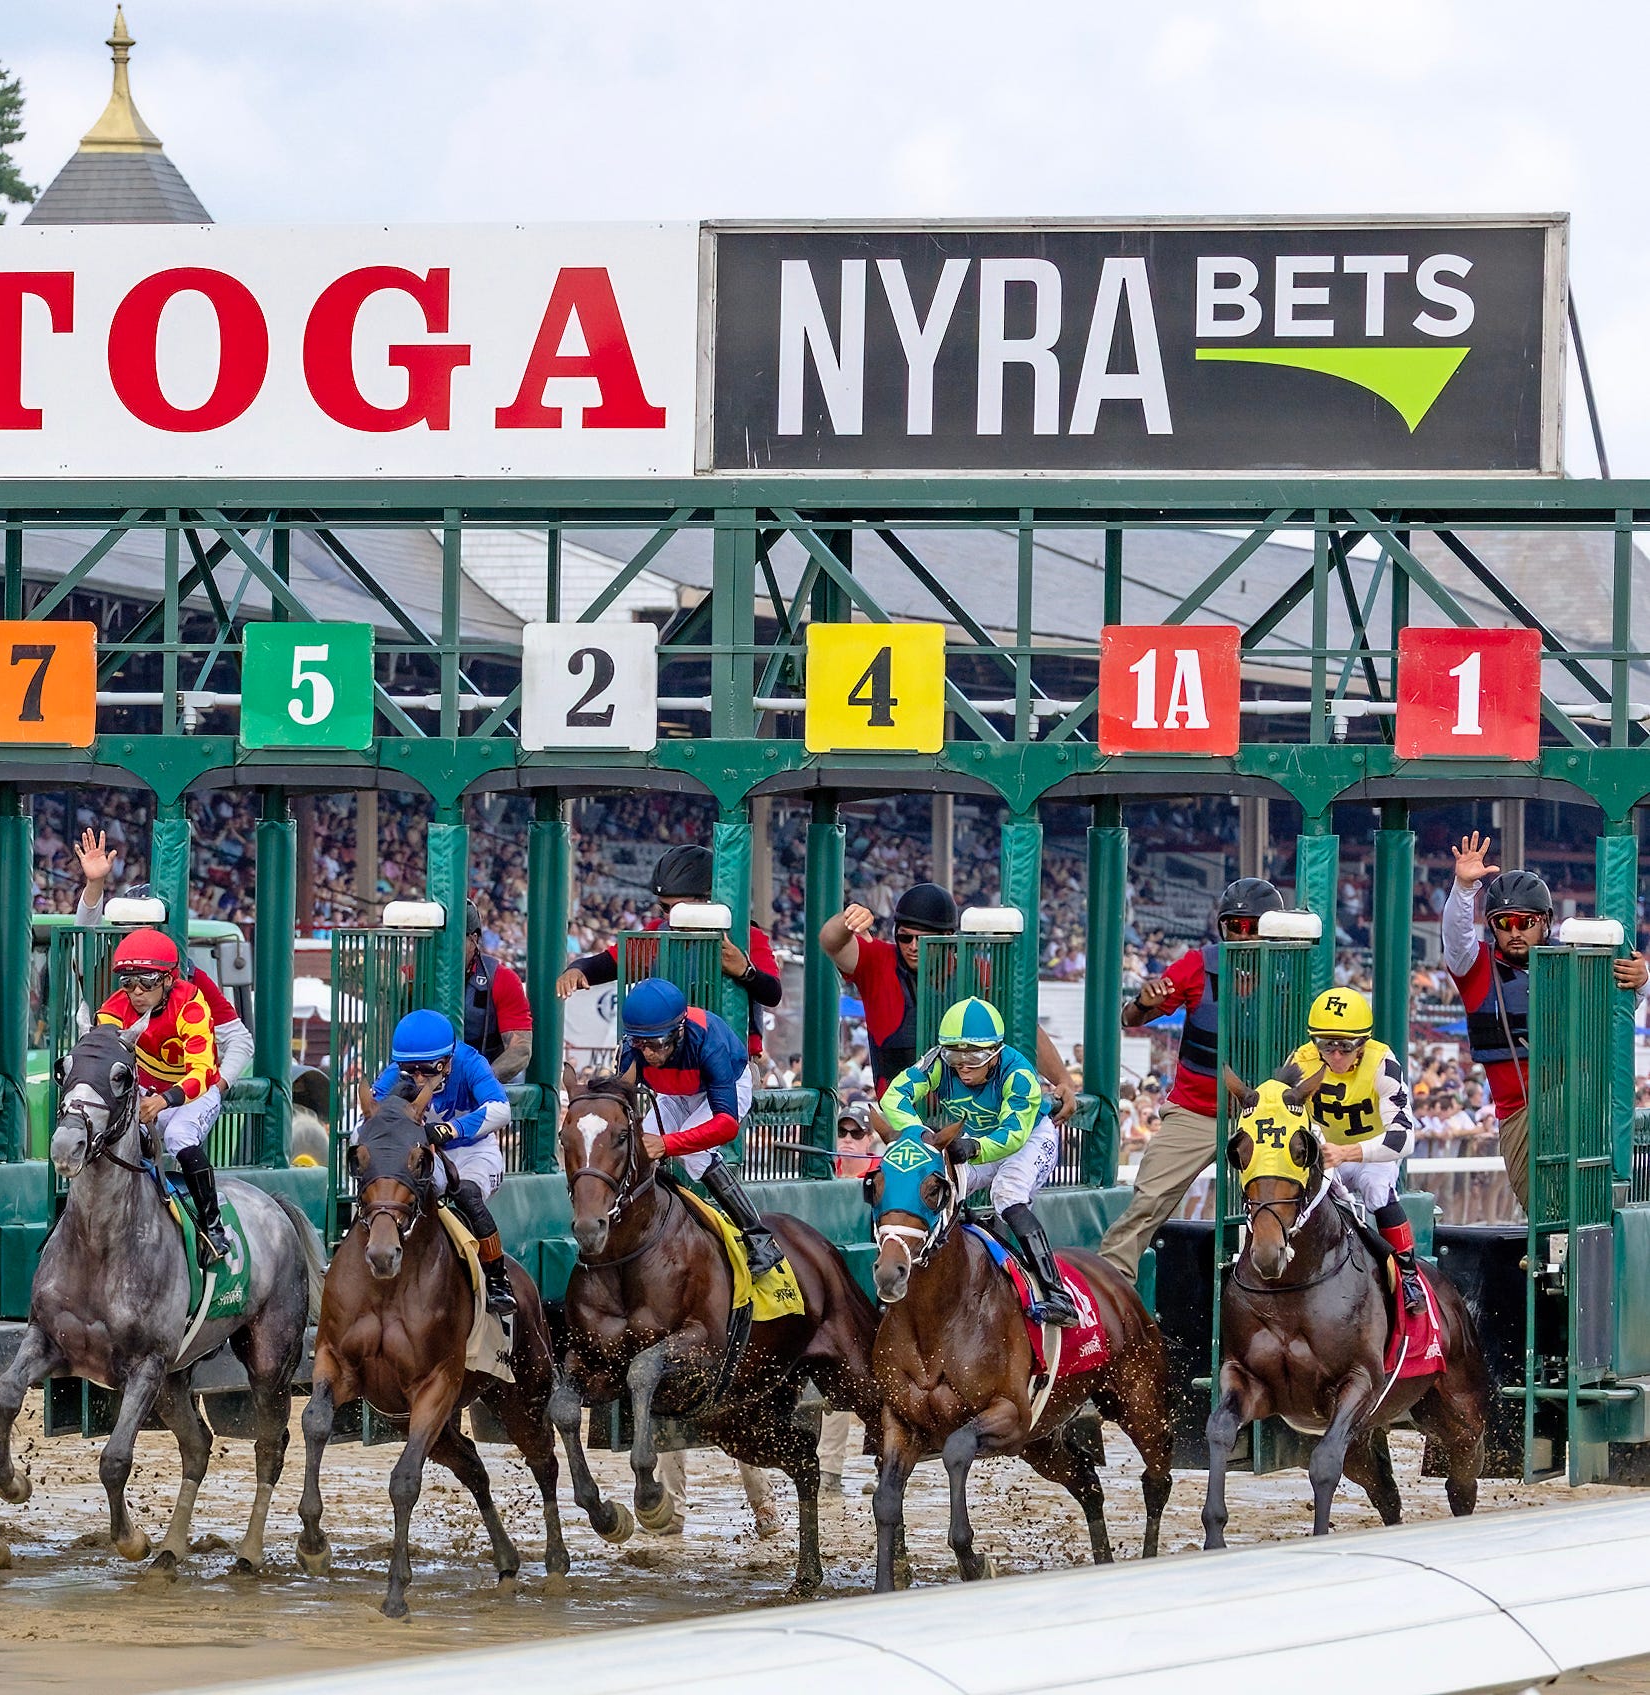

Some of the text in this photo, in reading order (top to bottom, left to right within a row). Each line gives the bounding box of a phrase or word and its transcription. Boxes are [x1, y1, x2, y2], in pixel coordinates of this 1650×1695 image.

[778, 254, 1475, 436] NYRA BETS
[10, 644, 57, 722] 7
[287, 643, 335, 726] 5
[566, 647, 615, 728] 2
[847, 646, 899, 727] 4
[1129, 648, 1210, 729] 1A
[1448, 651, 1483, 736] 1
[1324, 996, 1348, 1017] FT
[1255, 1117, 1287, 1149] FT
[1310, 1083, 1375, 1137] FT
